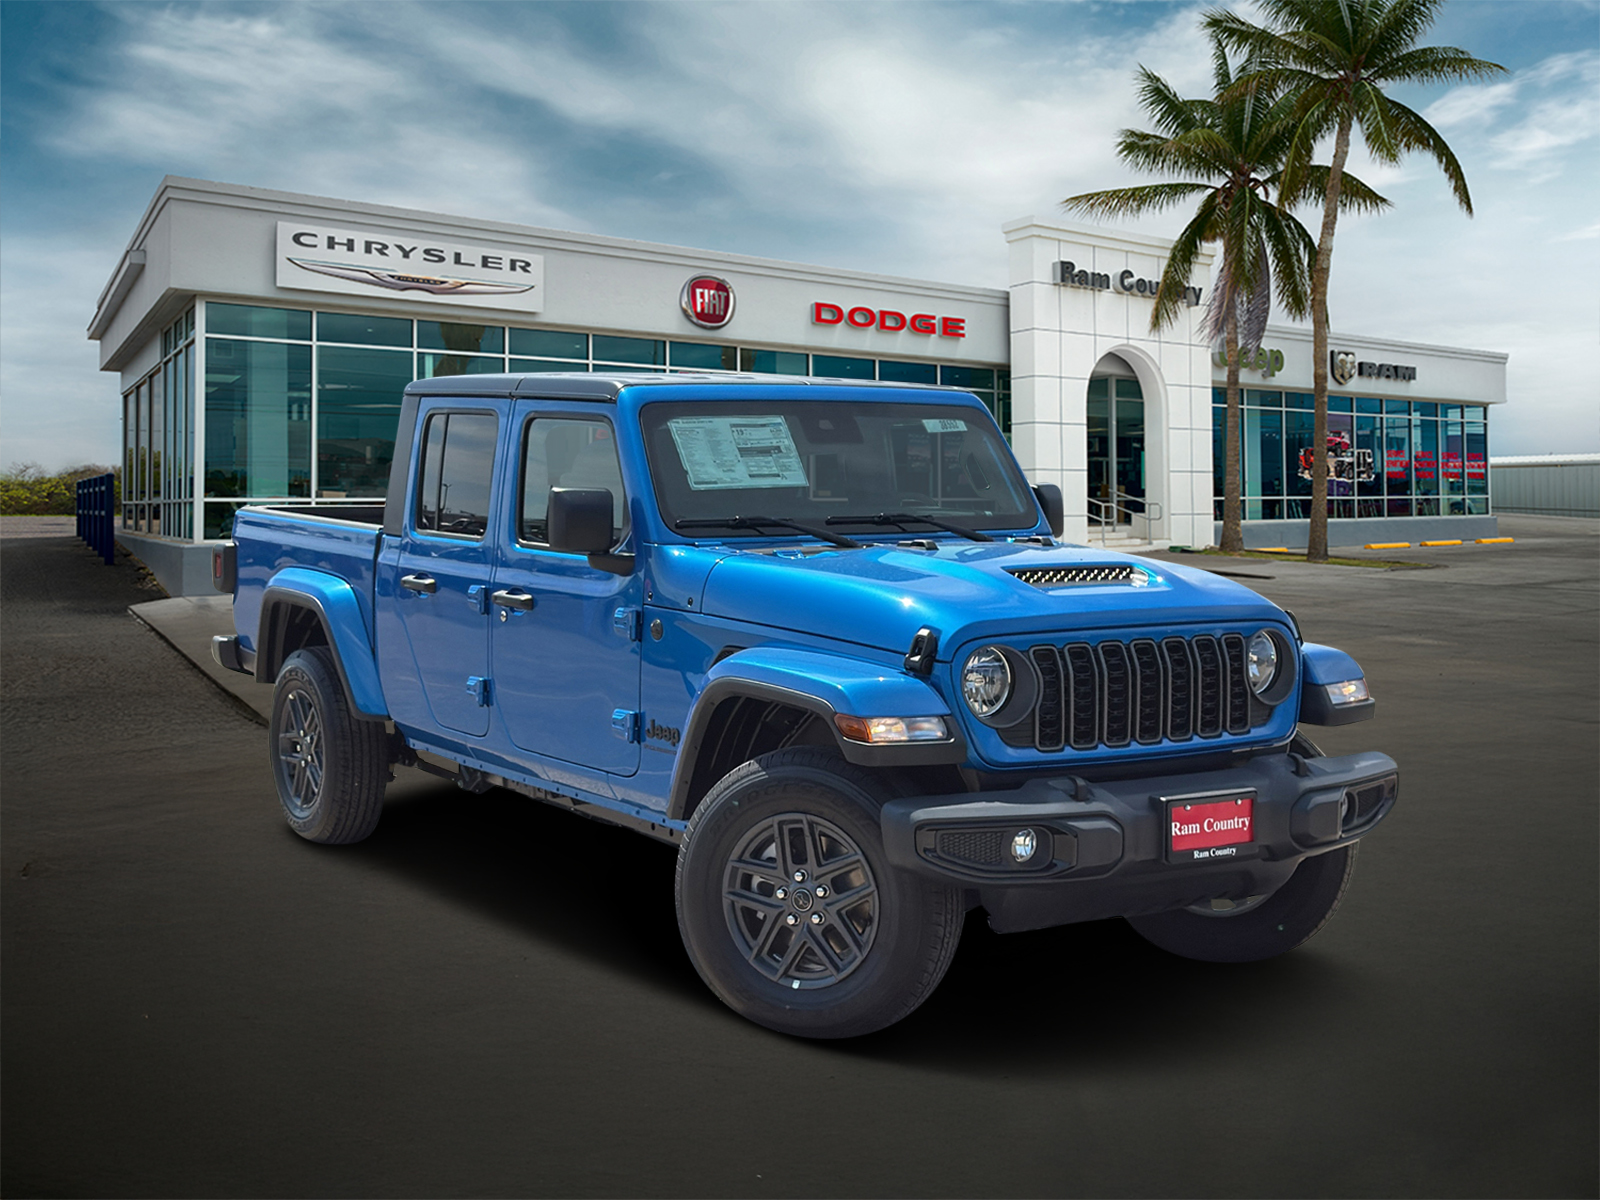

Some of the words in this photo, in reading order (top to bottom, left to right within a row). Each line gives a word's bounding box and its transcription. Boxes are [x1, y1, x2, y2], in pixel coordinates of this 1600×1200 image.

[291, 232, 533, 274] CHRYSLER
[1053, 260, 1111, 290] Ram
[1113, 269, 1203, 307] Coury
[695, 288, 728, 316] FIAT
[812, 302, 966, 338] DODGE
[1358, 361, 1417, 381] RAM
[645, 719, 680, 746] Jeep
[1171, 821, 1200, 836] Ram
[1203, 816, 1251, 832] Country
[1193, 850, 1209, 859] Ram
[1210, 847, 1236, 857] Country
